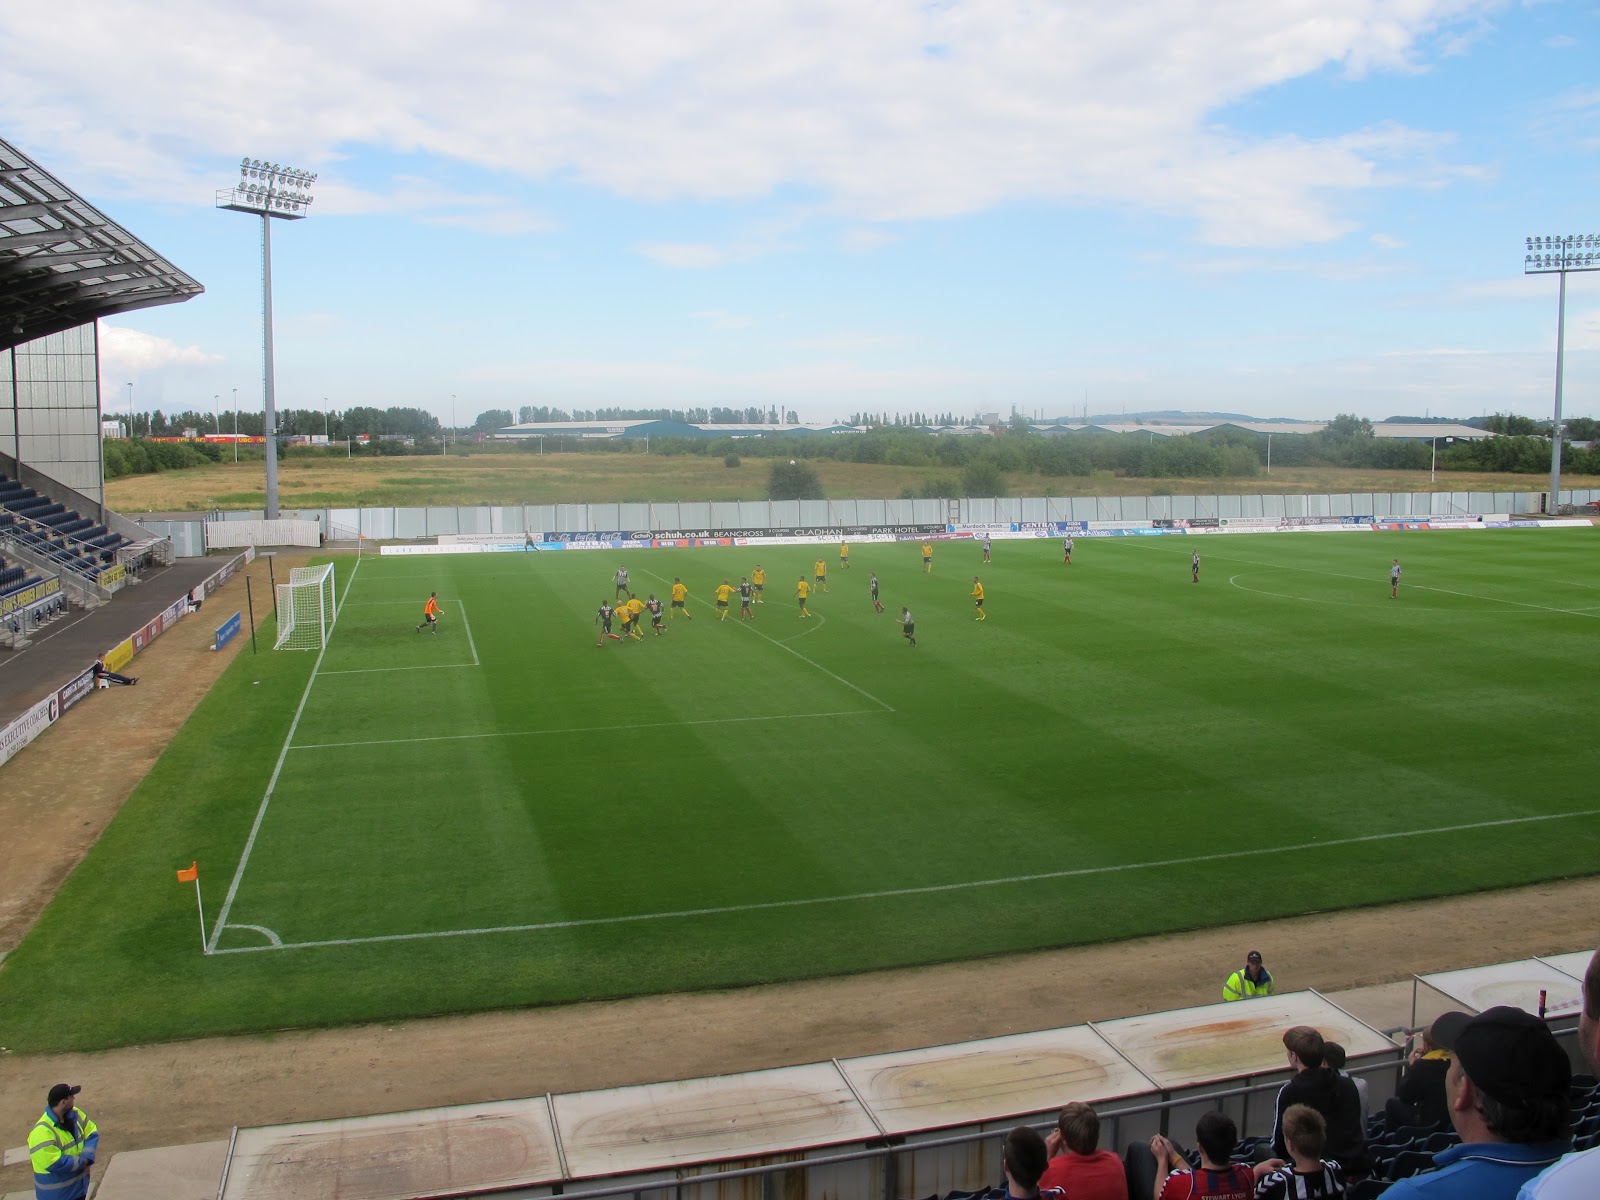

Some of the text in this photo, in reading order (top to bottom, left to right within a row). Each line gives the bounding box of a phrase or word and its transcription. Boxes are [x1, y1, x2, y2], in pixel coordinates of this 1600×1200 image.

[794, 528, 843, 536] CLADHAN
[894, 525, 919, 533] HOTEL
[574, 532, 599, 542] Coca-Cola
[600, 531, 623, 542] Coca-Cola
[655, 531, 709, 539] schuh.co.uk
[5, 718, 30, 748] EXECUTIVE
